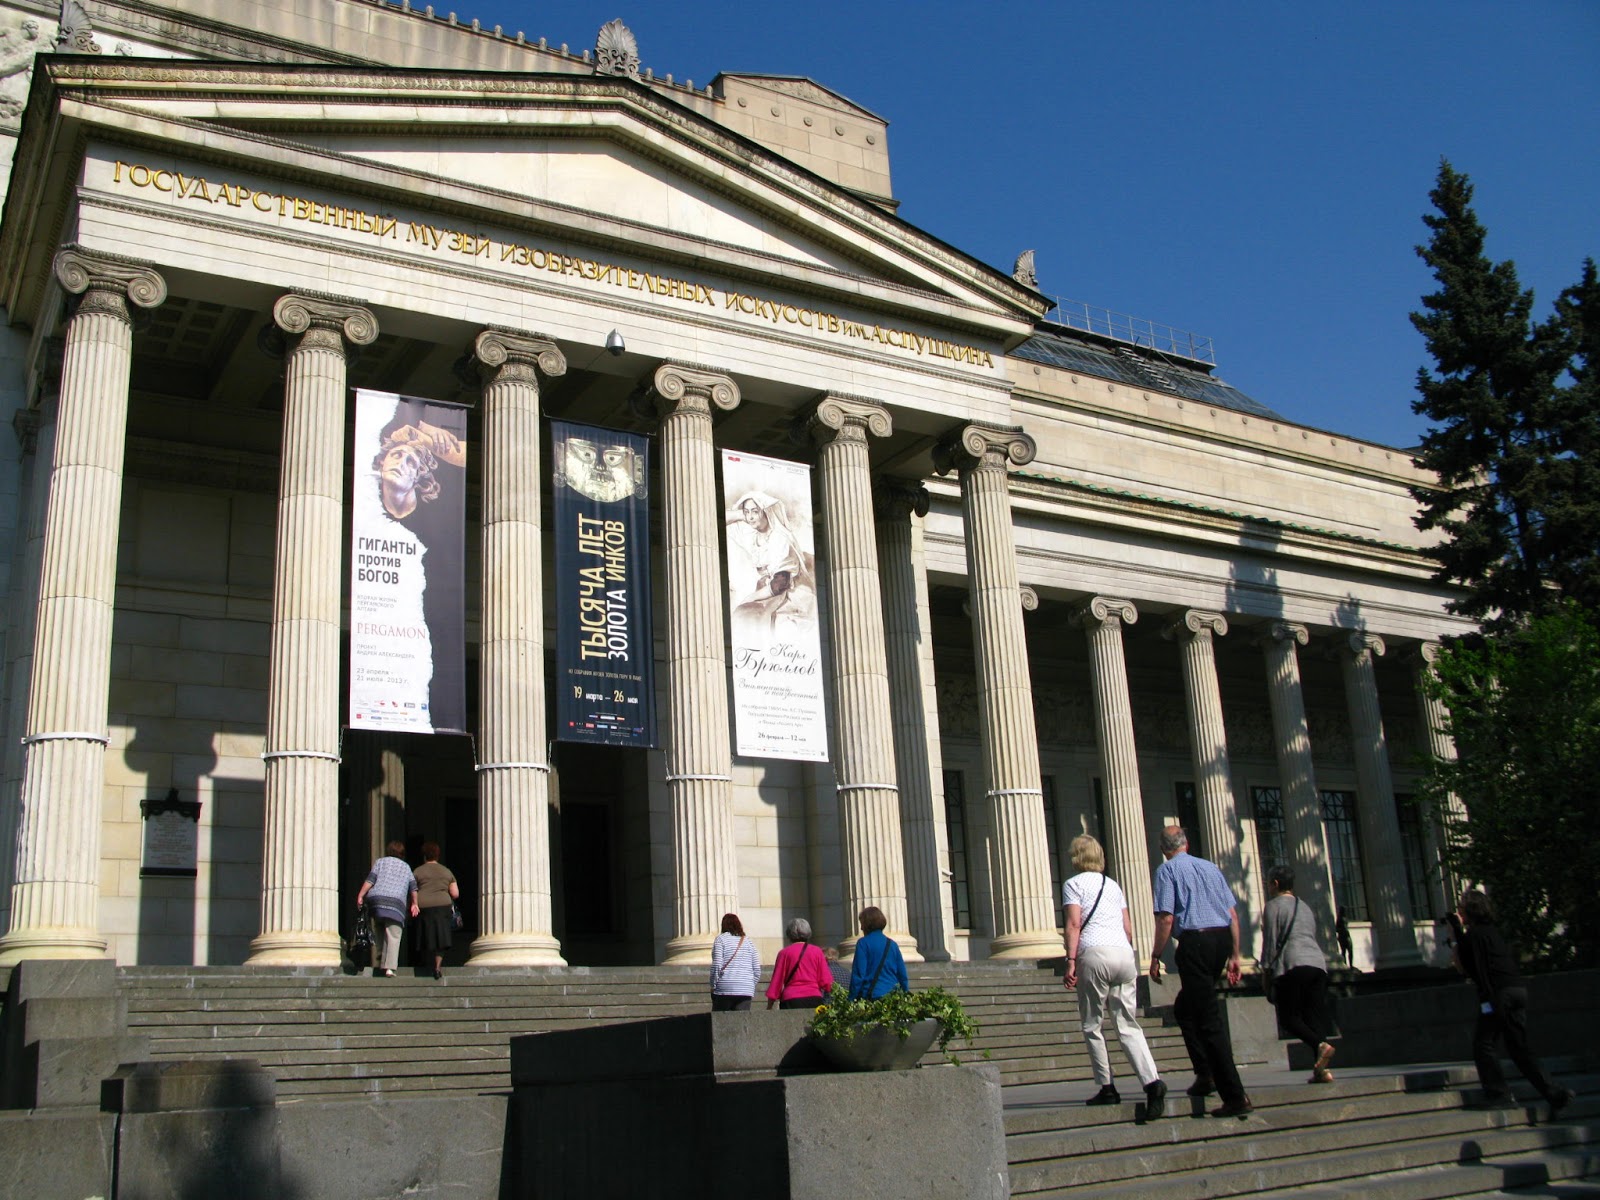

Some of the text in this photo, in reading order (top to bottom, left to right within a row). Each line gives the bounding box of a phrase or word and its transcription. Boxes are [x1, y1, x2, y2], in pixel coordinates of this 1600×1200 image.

[113, 160, 397, 239] ГОСУДАРСТВЕННЫЙ
[406, 221, 491, 259] МУЗЕЙ
[500, 241, 716, 307] ИЗОБРАЗИТЕЛЬНЫХ
[724, 290, 841, 333] ИСКУССТВ
[359, 537, 416, 556] ГИГАНТЫ
[359, 554, 401, 568] против
[358, 568, 399, 584] БОГОВ
[578, 512, 607, 660] ТЫСЯЧА ЛЕТ
[604, 520, 628, 662] ЗОЛОТА ИНКОВ
[357, 622, 426, 640] PERGAMON
[734, 646, 818, 678] Брюллов
[770, 643, 808, 663] Карл
[574, 686, 583, 699] 19
[585, 693, 603, 703] марта
[613, 690, 624, 703] 26
